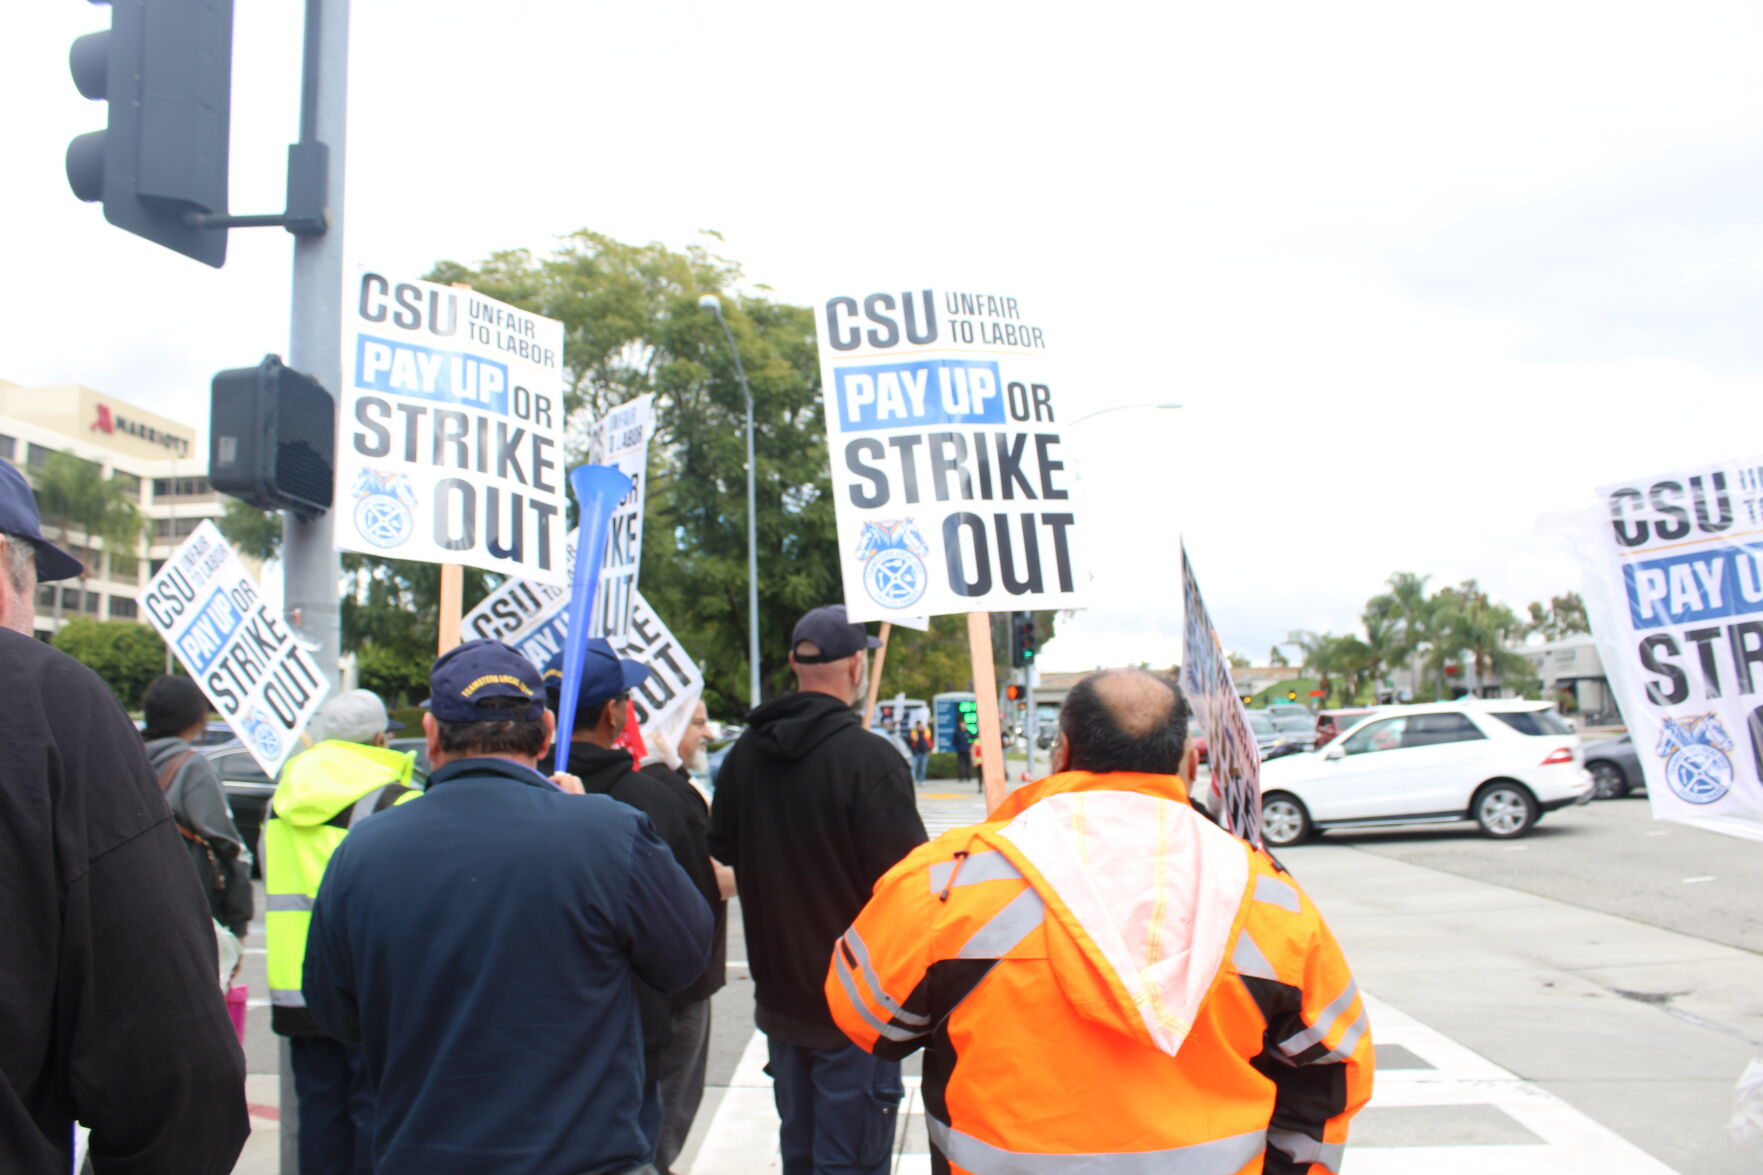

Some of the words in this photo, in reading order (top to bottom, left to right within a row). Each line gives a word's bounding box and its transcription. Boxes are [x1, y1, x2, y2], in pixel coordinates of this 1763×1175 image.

[359, 272, 458, 337] CSU
[469, 297, 536, 340] UNFAIR
[825, 289, 938, 352] CSU
[945, 291, 1020, 320] UNFAIR
[948, 319, 974, 344] TO
[981, 321, 1046, 349] LABOR
[362, 340, 443, 394] PAY
[450, 355, 505, 404] UP
[468, 320, 491, 345] TO
[497, 330, 555, 369] LABOR
[513, 385, 553, 430] OR
[844, 368, 929, 423] PAY
[938, 366, 997, 415] UP
[1007, 381, 1055, 423] OR
[353, 395, 556, 495] STRIKE
[844, 431, 1069, 510] STRIKE
[433, 477, 558, 571] OUT
[1609, 471, 1733, 547] CSU
[942, 511, 1075, 597] OUT
[147, 566, 196, 630] CSU
[231, 578, 258, 613] OR
[472, 582, 543, 640] CSU
[1634, 556, 1724, 620] PAY
[180, 617, 223, 669] PAY
[208, 592, 236, 636] UP
[207, 604, 288, 716] STRIKE
[263, 645, 319, 730] OUT
[1638, 621, 1763, 706] STR
